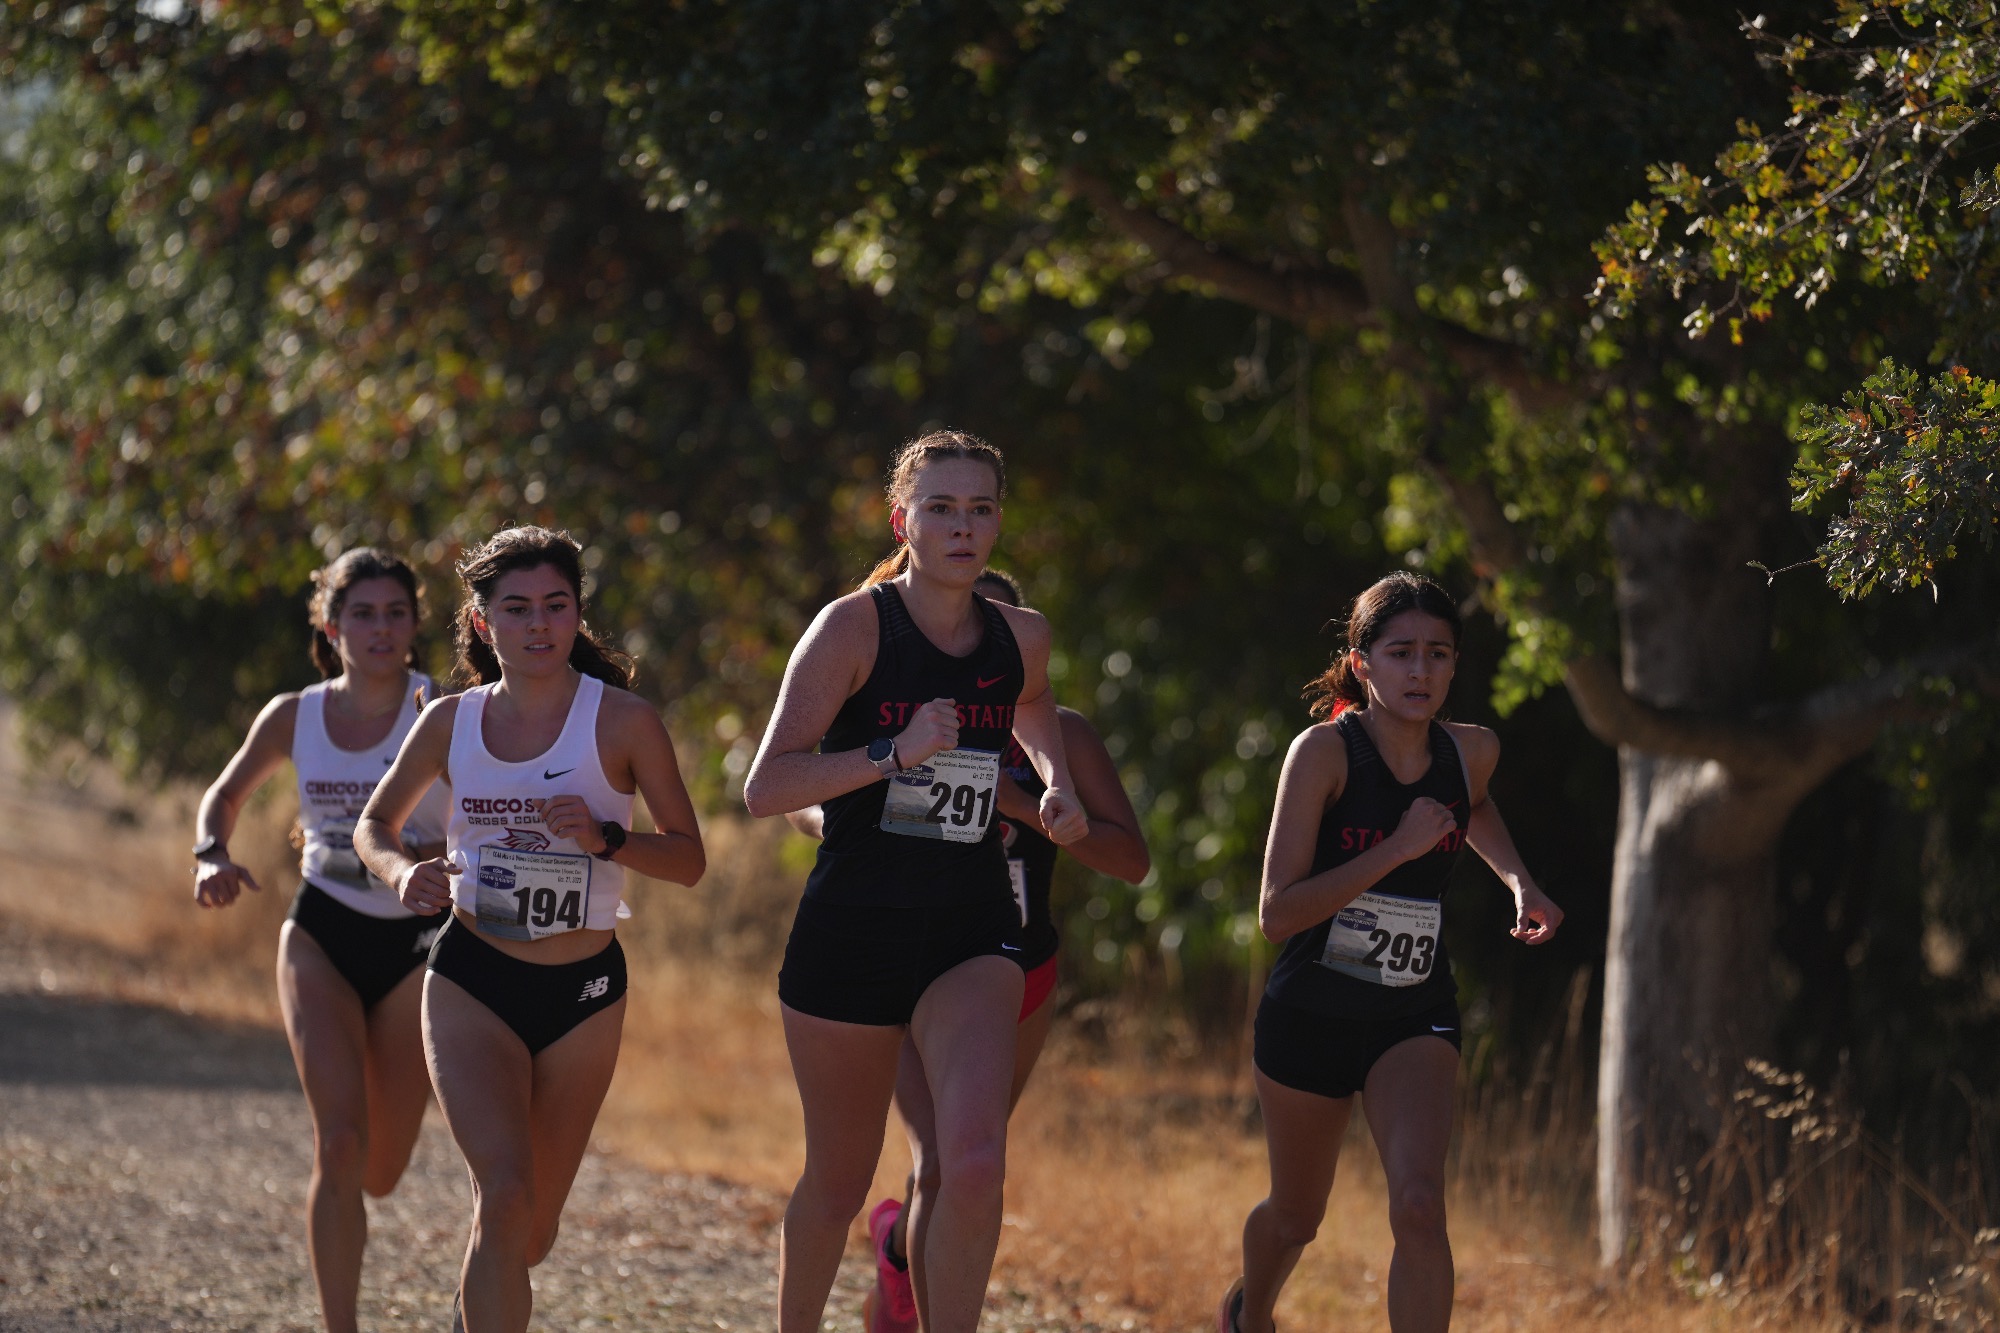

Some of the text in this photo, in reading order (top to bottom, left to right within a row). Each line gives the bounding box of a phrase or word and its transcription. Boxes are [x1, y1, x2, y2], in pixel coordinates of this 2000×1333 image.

[878, 701, 927, 726] STA
[305, 780, 359, 795] CHICO
[461, 797, 523, 814] CHICO
[925, 781, 993, 828] 291
[468, 815, 508, 826] CROSS
[1341, 827, 1386, 851] STA
[513, 886, 581, 929] 194
[1362, 928, 1435, 975] 293
